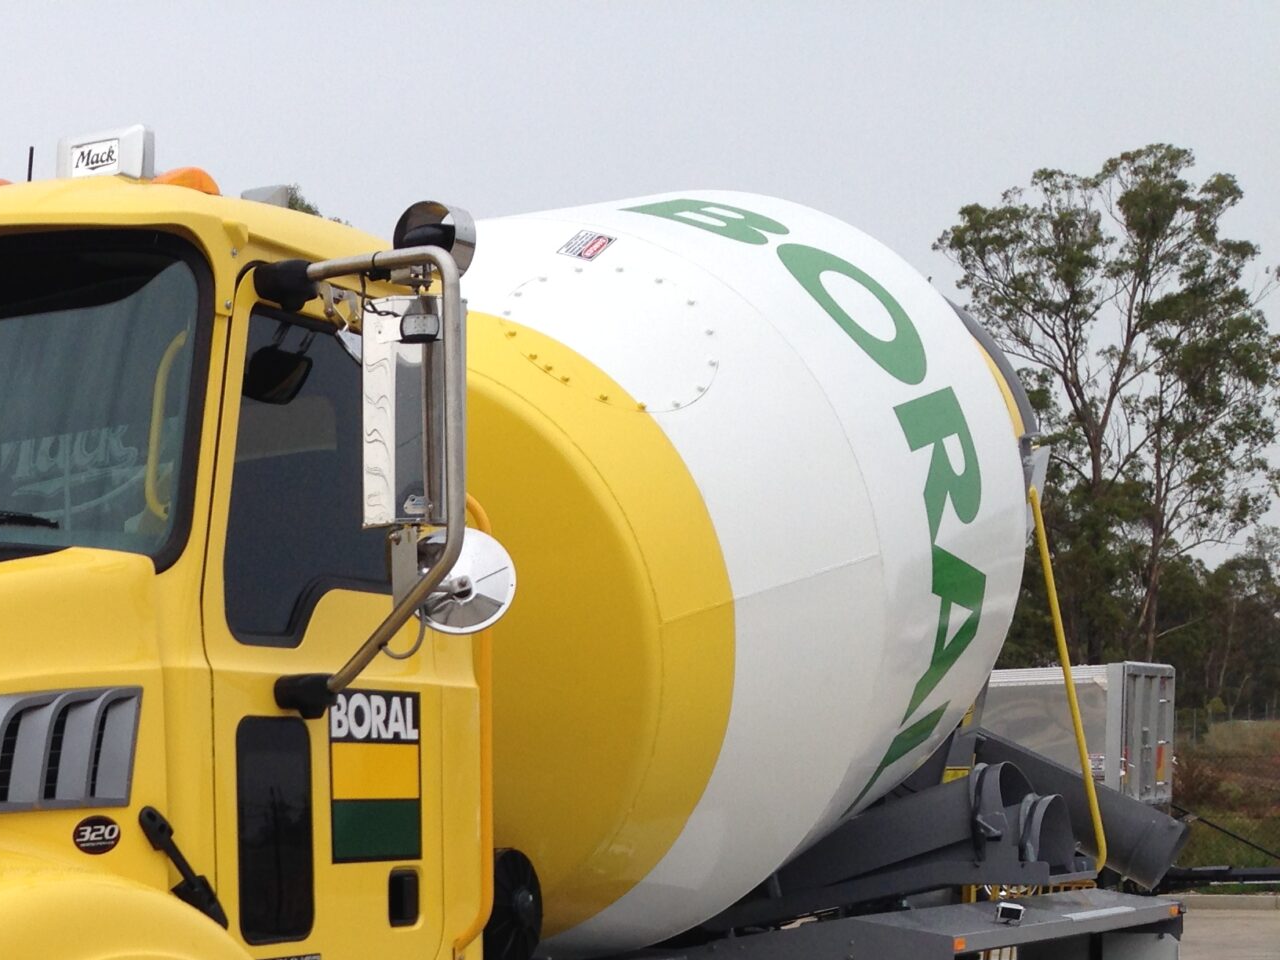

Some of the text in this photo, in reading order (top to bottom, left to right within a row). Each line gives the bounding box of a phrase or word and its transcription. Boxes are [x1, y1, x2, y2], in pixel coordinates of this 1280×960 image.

[75, 145, 117, 169] Mack
[617, 198, 988, 819] BORAL
[330, 692, 419, 740] BORAL
[76, 824, 119, 842] 320
